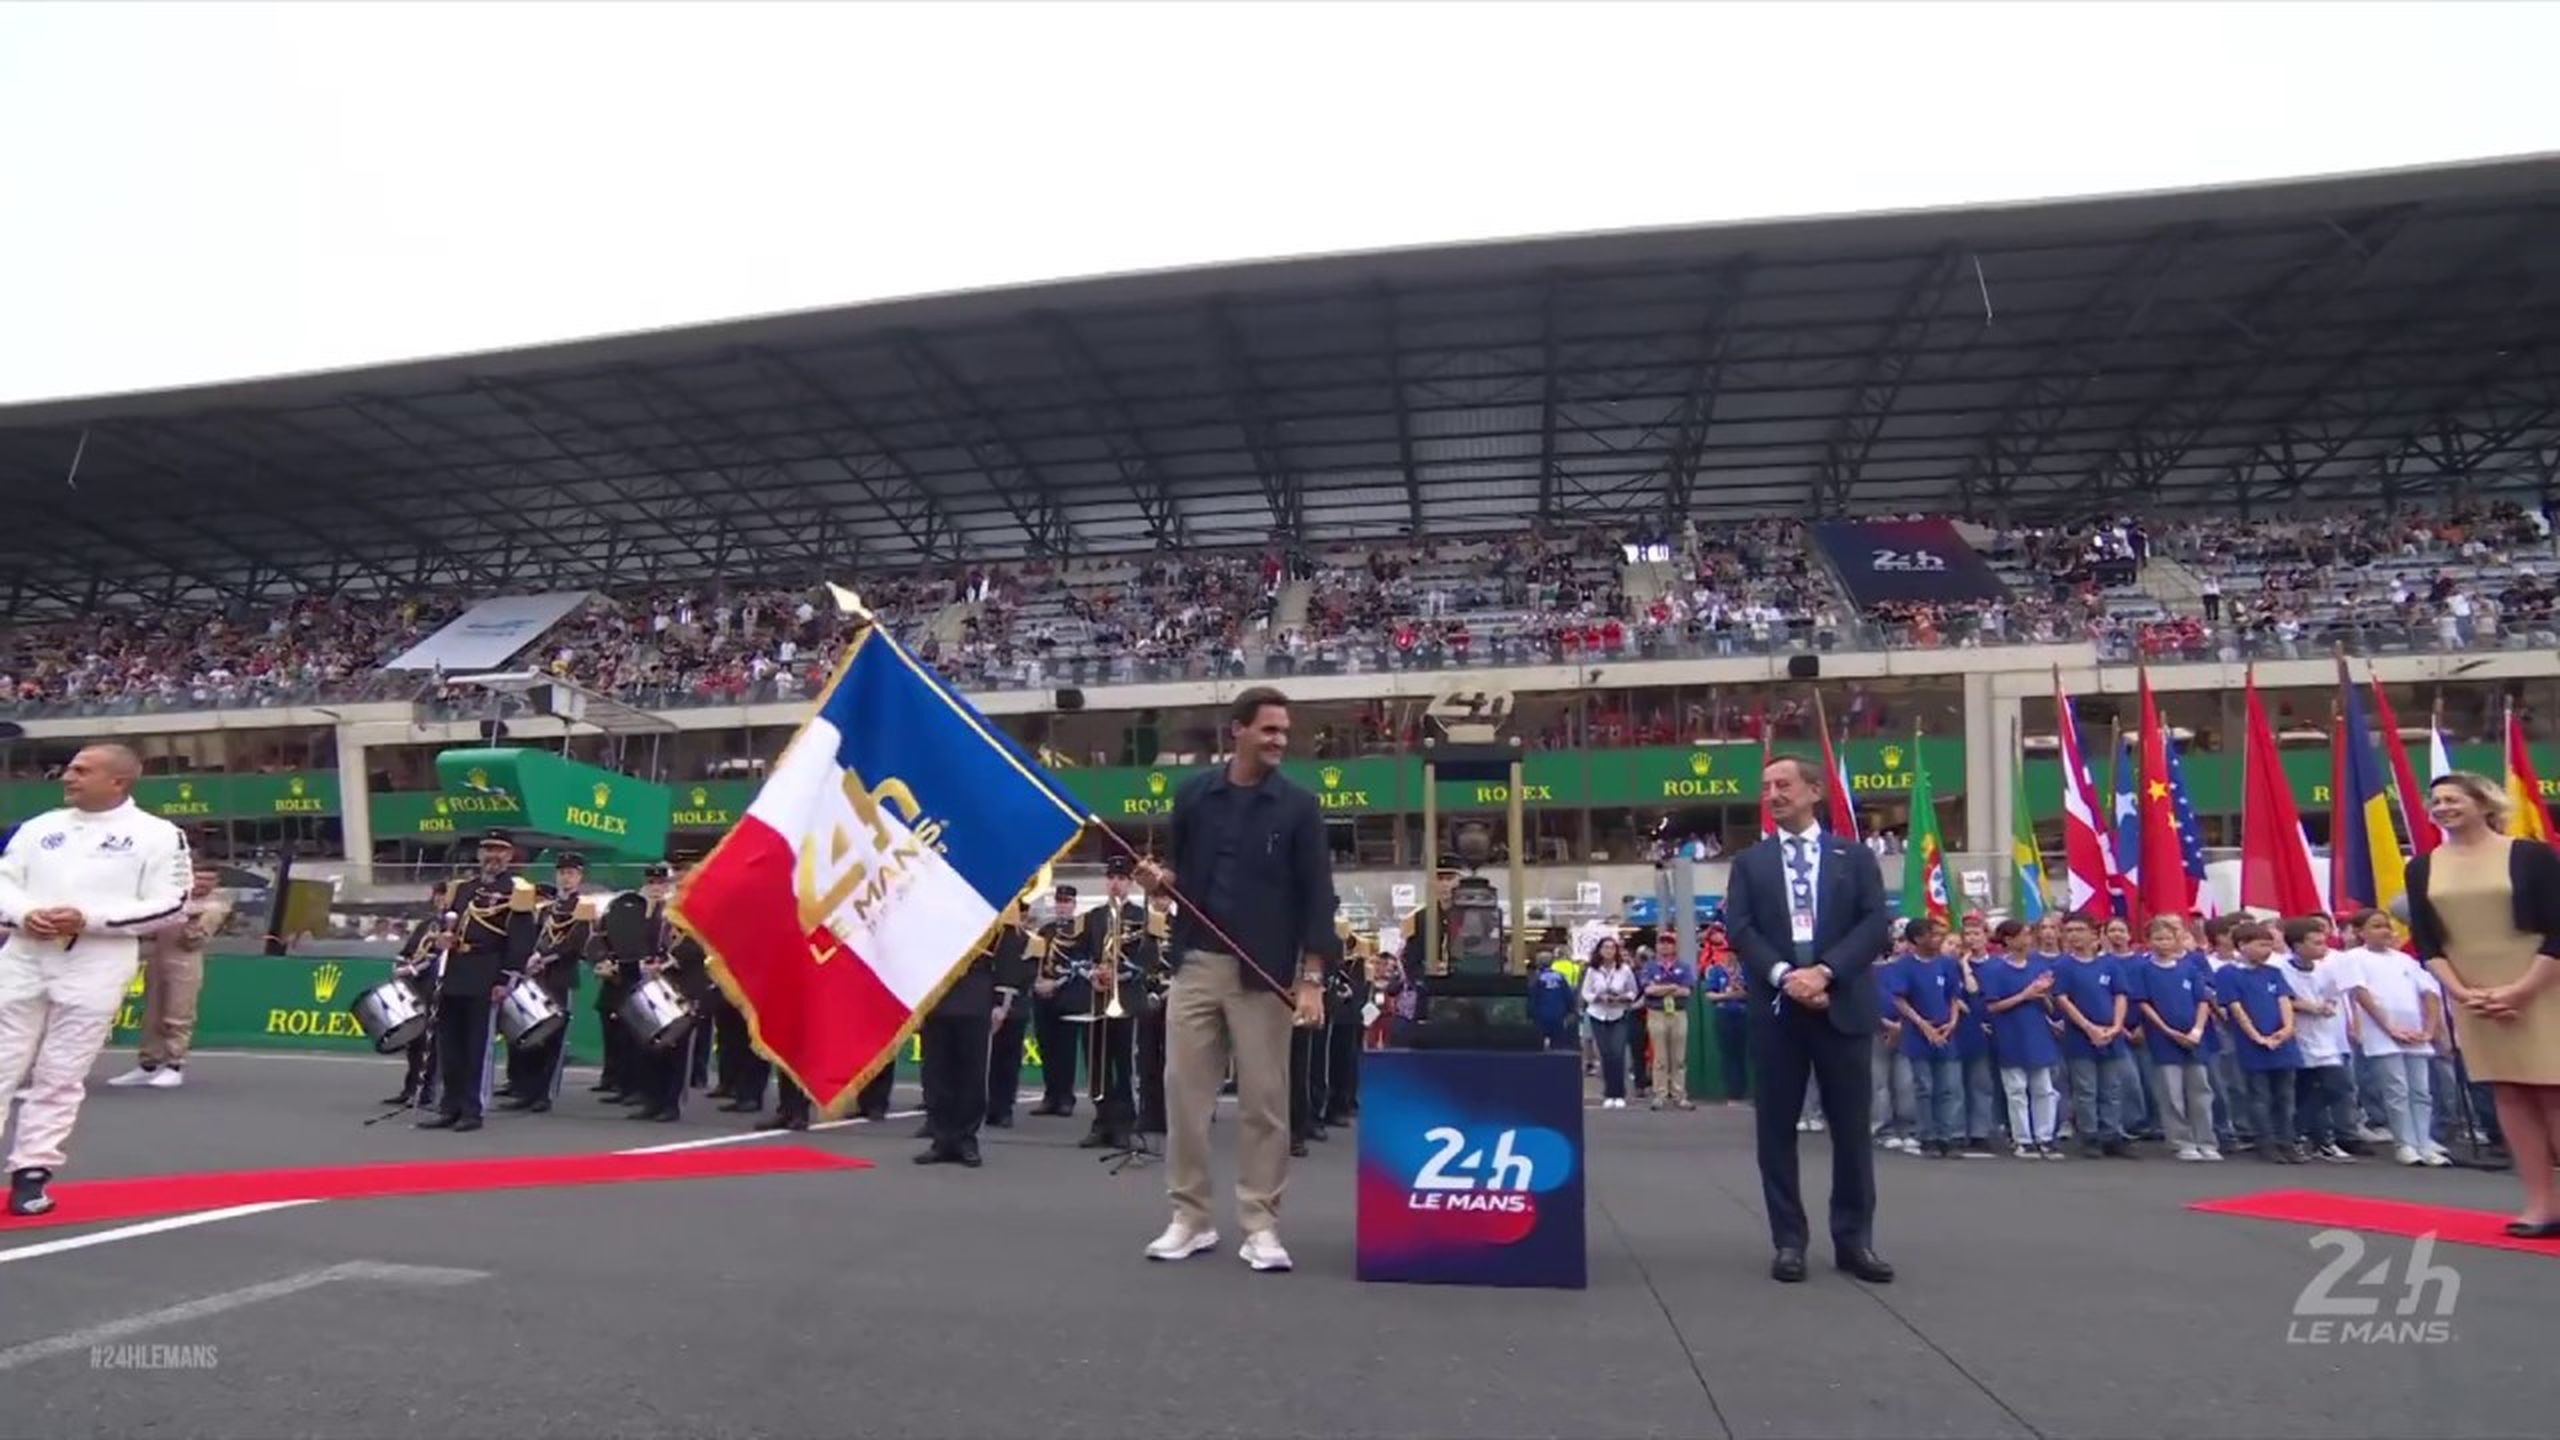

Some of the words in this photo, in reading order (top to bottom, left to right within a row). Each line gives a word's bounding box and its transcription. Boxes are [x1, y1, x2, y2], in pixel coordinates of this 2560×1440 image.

[1664, 779, 1740, 797] ROLEX
[1854, 772, 1931, 789] ROLE
[1319, 791, 1369, 808] LEX
[1477, 785, 1552, 802] ROEX
[163, 801, 209, 815] ROLEX
[275, 798, 322, 812] ROLEX
[449, 796, 520, 811] ROLEX
[1124, 798, 1175, 814] ROLE
[566, 806, 628, 834] ROLEX
[672, 810, 728, 825] ROLEX
[266, 1009, 366, 1038] ROLEX
[1413, 1126, 1534, 1191] 24h
[1408, 1192, 1443, 1209] LE
